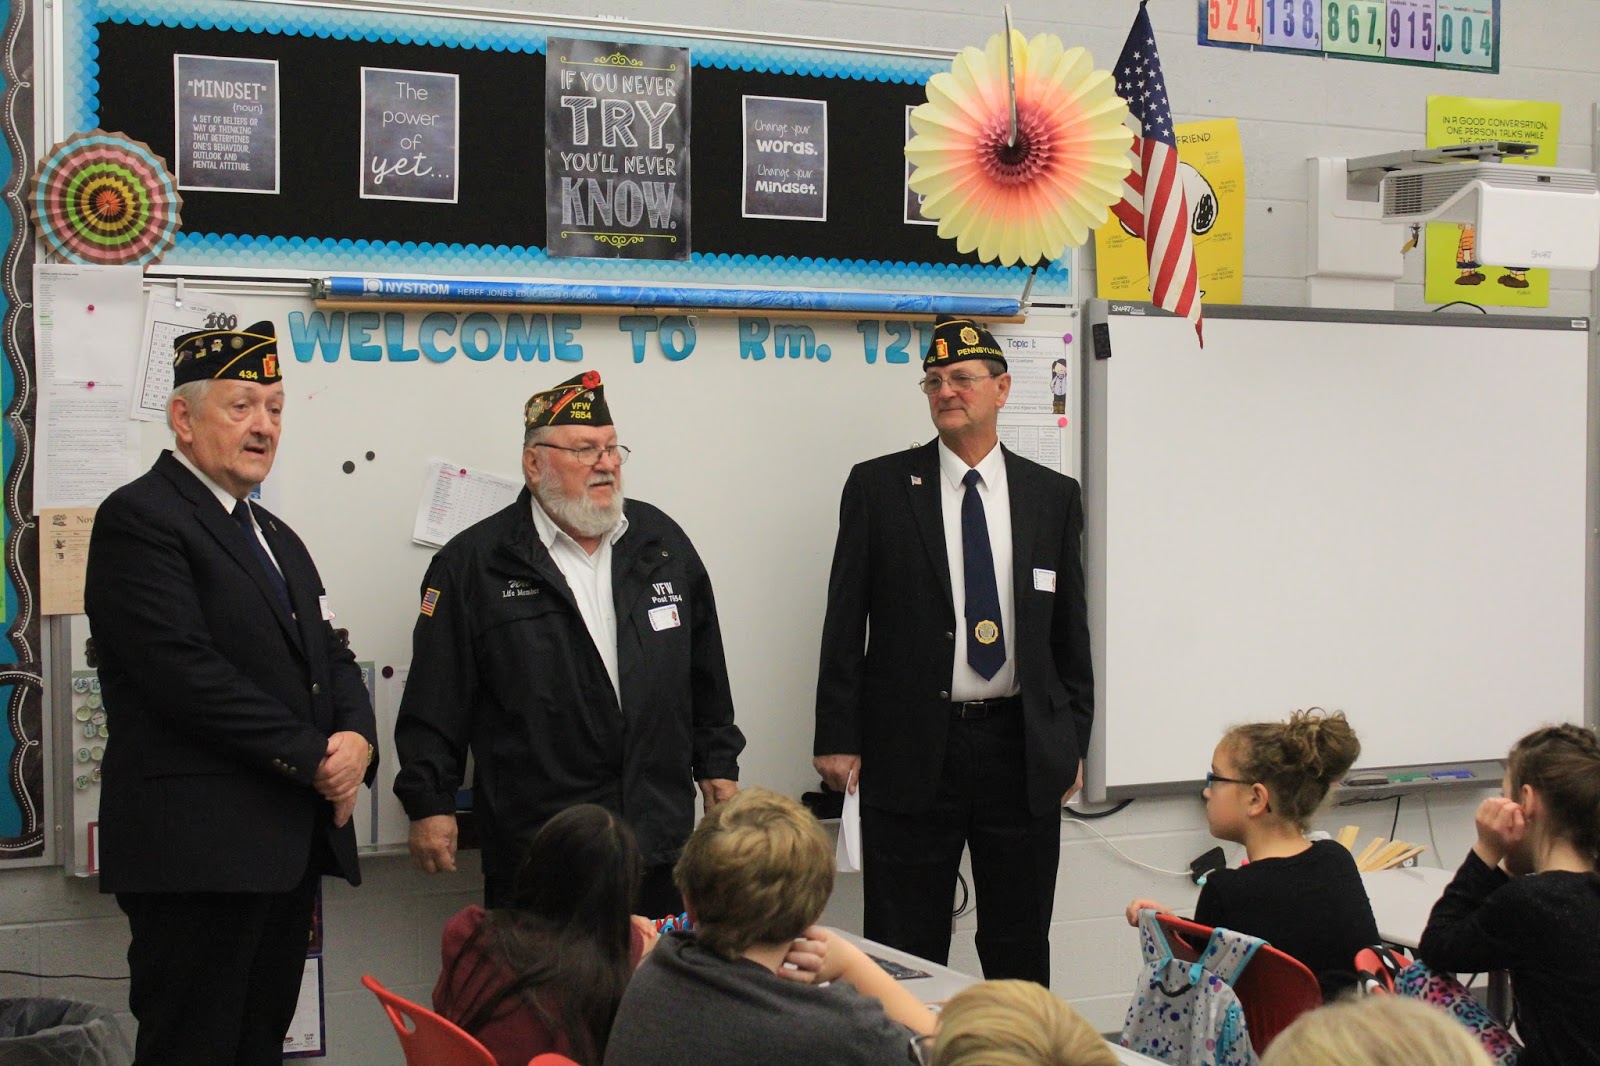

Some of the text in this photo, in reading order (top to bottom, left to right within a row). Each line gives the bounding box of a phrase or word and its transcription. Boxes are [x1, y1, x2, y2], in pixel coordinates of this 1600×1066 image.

[395, 81, 428, 100] The
[561, 70, 676, 97] IF YOU NEVER
[200, 115, 211, 123] SET
[213, 116, 221, 124] OF
[223, 116, 248, 126] BELIEFS
[250, 118, 258, 126] OR
[383, 110, 440, 127] power
[561, 95, 677, 154] TRY,
[1459, 117, 1486, 126] GOOD
[1488, 118, 1548, 130] CONVERSATION,
[193, 124, 252, 134] WAY OF THINKING
[755, 119, 811, 138] Change your
[1447, 126, 1544, 140] ONE PERSON TALKS WHILE
[193, 133, 250, 144] THAT DETERMINES
[400, 134, 423, 150] of
[1176, 133, 1211, 144] FRIEND
[193, 142, 212, 151] ONE'S
[756, 139, 818, 156] words.
[193, 151, 238, 161] OUTLOOK AND
[193, 160, 217, 170] MENTAL
[371, 152, 449, 185] yet...
[561, 152, 676, 176] YOU'LL NEVER
[757, 164, 813, 182] Change your
[755, 180, 818, 195] Mindset.
[561, 176, 677, 230] KNOW.
[386, 282, 598, 300] NYSTROM HERFF JONES EDUCATION DIVISION
[288, 310, 584, 363] WELCOME
[618, 315, 697, 364] TO
[738, 316, 832, 363] Rm.
[1007, 338, 1028, 349] Topic
[239, 370, 258, 380] 434
[572, 402, 591, 410] VFW
[570, 411, 591, 419] 7654
[502, 590, 515, 598] Life
[652, 582, 674, 595] VFW
